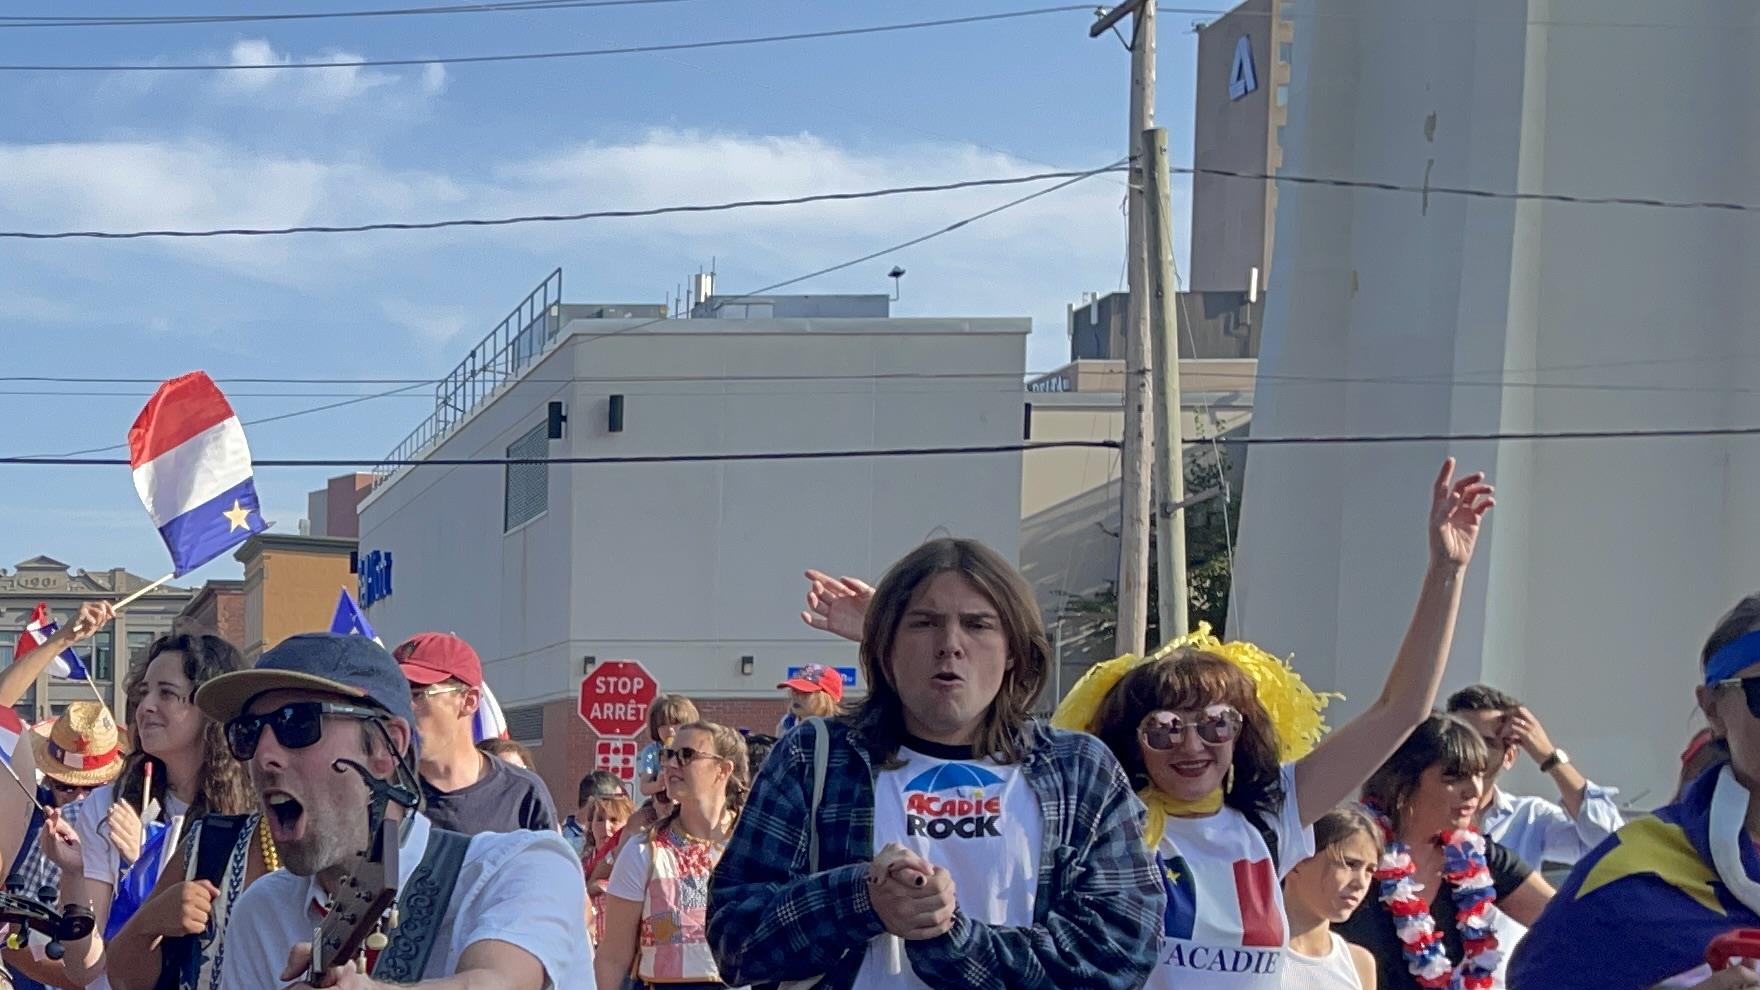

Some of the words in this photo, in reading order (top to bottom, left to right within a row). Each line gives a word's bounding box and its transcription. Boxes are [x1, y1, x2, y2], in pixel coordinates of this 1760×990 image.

[24, 577, 57, 588] 1901
[595, 676, 644, 694] STOP
[589, 698, 648, 721] ARRÊT
[906, 794, 1000, 817] ACADIE
[906, 814, 1002, 839] ROCK
[1162, 940, 1281, 974] 'ACADIE
